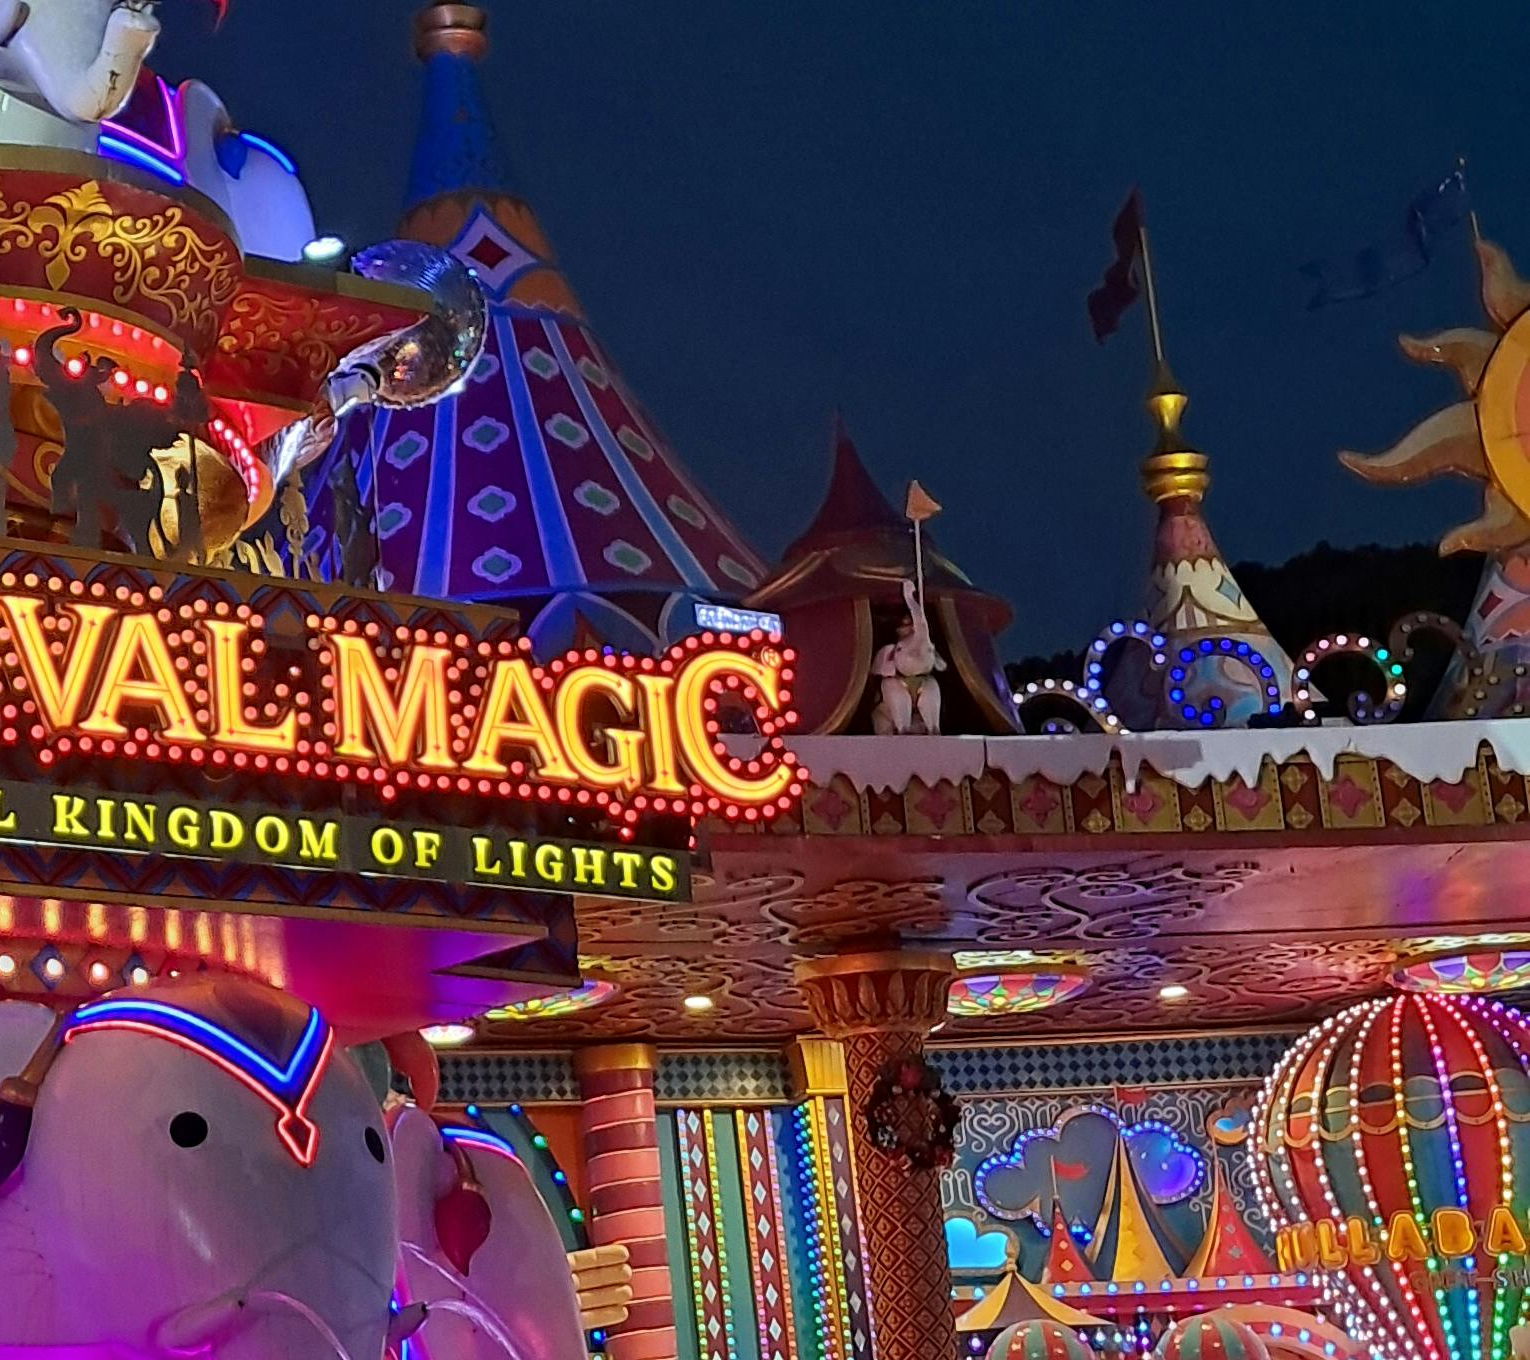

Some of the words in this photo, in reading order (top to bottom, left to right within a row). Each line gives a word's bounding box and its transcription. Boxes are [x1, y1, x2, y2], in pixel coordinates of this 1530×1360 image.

[325, 632, 791, 802] MAGIC
[52, 792, 338, 860] KINGDOM
[371, 826, 441, 869] OF
[472, 835, 676, 892] LIGHTS
